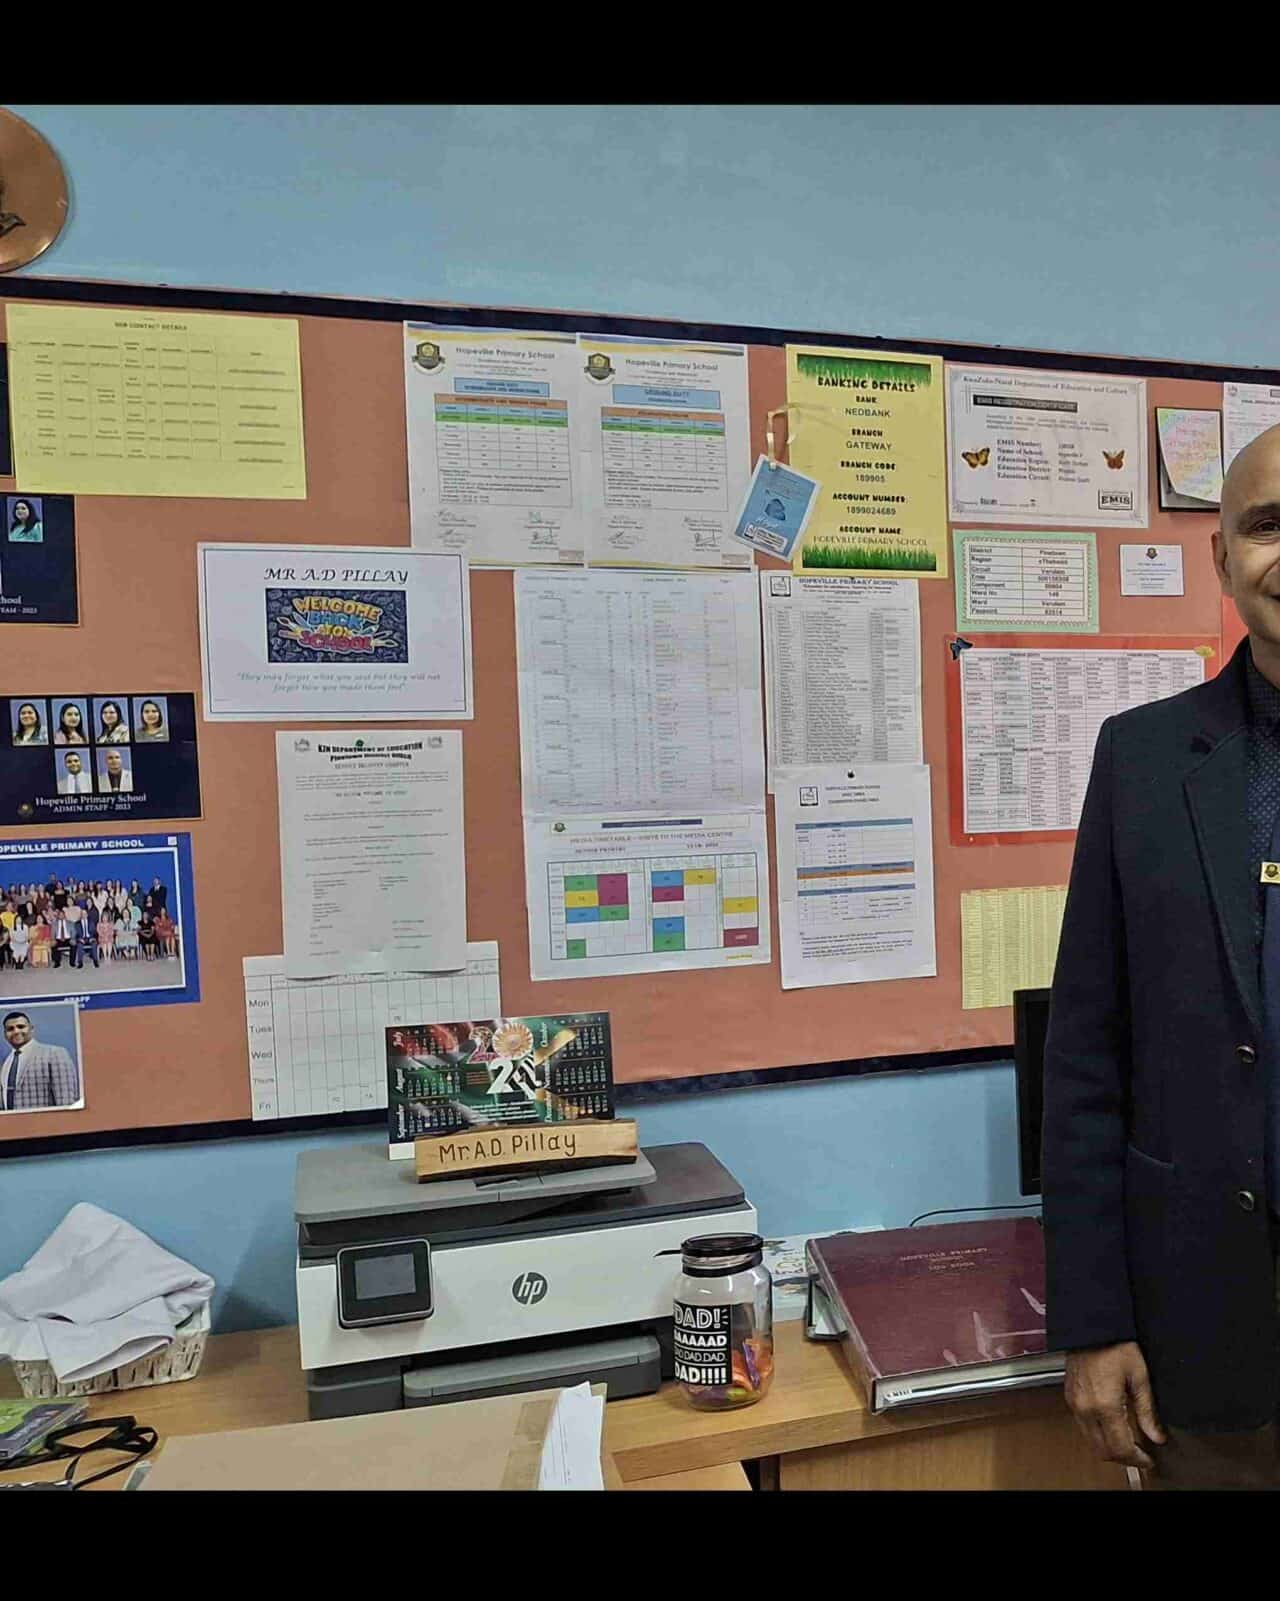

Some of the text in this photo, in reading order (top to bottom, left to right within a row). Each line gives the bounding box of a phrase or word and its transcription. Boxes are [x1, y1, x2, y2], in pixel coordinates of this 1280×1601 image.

[495, 349, 525, 358] Primary
[528, 352, 556, 360] School
[663, 361, 690, 370] Primary
[692, 362, 719, 370] School
[818, 377, 916, 393] BANKING DETAILS
[845, 408, 892, 418] NEDBANK
[852, 429, 883, 437] BRANCH
[846, 441, 892, 451] GATEWAY
[840, 461, 896, 470] BRANCH CODE
[832, 493, 870, 502] ACCOUNT
[1101, 495, 1131, 505] EMIS
[839, 526, 876, 534] ACCOUNT
[858, 536, 894, 545] PRIMARY
[897, 538, 928, 546] SCHOOL
[263, 567, 297, 581] MR
[341, 568, 409, 585] PILLAY
[295, 597, 381, 621] WELCOME
[309, 611, 363, 629] BACK
[300, 631, 373, 652] SCHOOL
[386, 742, 423, 751] EDUCATION
[35, 794, 147, 806] Hopeville Primary School
[53, 804, 83, 813] ADMIN
[84, 803, 109, 811] STAFF
[50, 841, 99, 851] PRIMARY
[101, 839, 145, 849] SCHOOL
[249, 999, 270, 1008] Mon
[251, 1051, 273, 1060] Wed
[512, 1132, 576, 1157] Pillay
[516, 1272, 545, 1305] hp
[673, 1302, 721, 1329] DAD!
[703, 1353, 726, 1363] DAD
[674, 1361, 727, 1385] DAD!!!!
